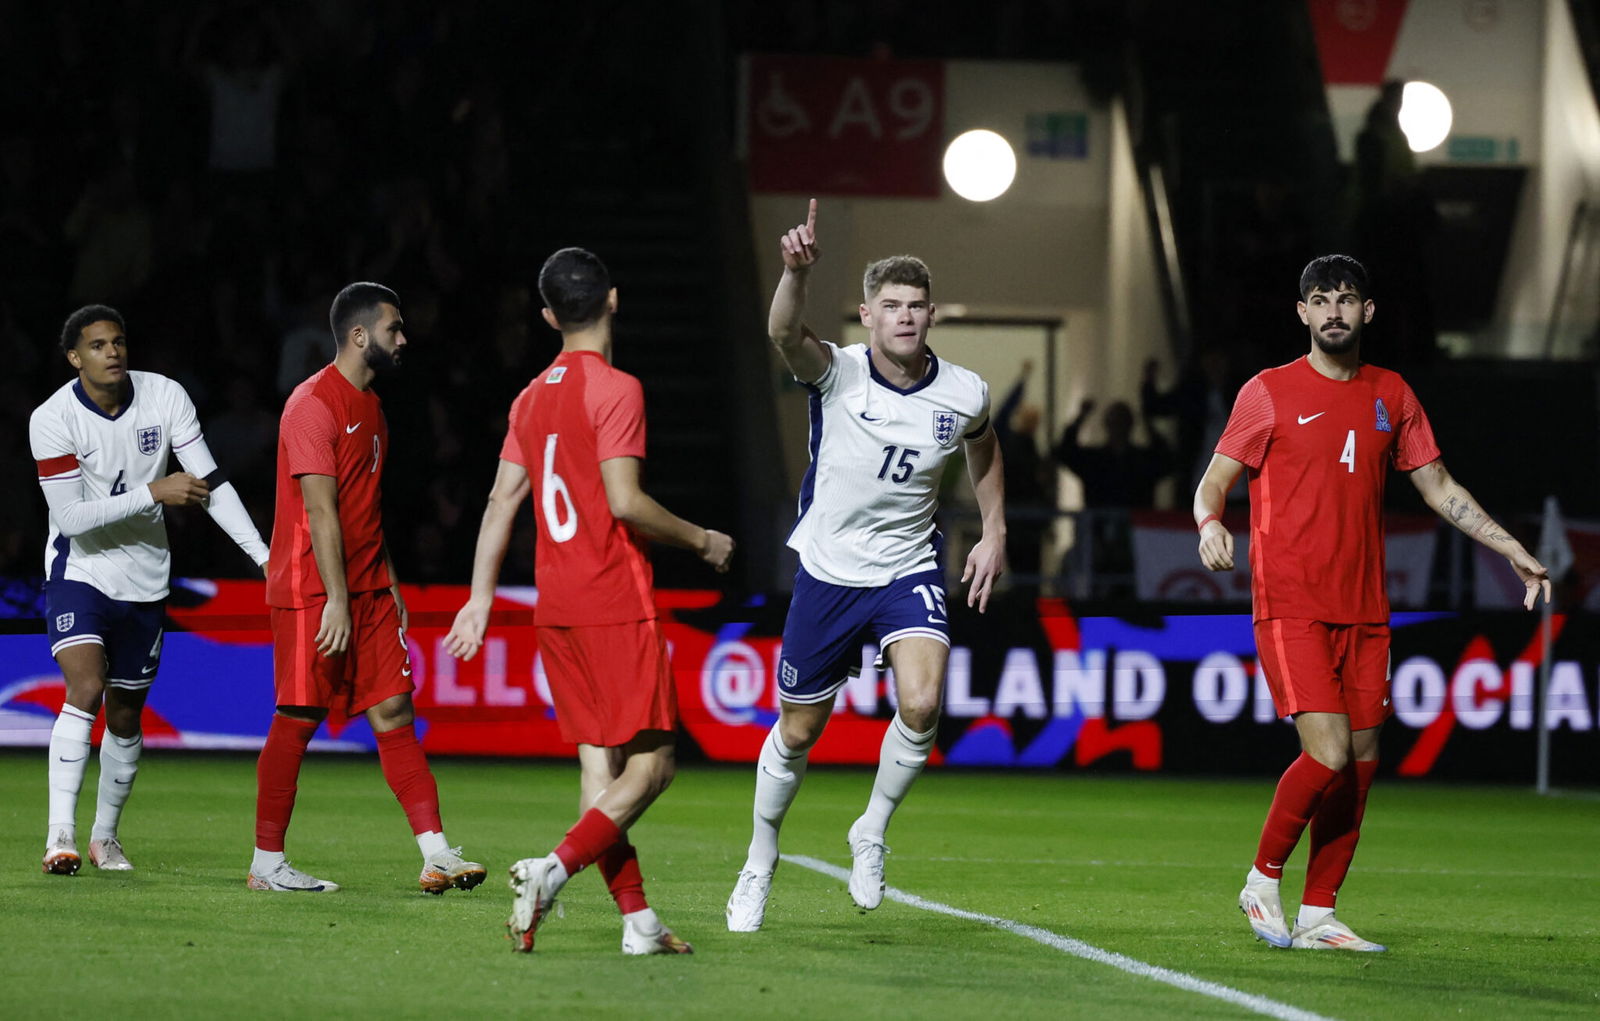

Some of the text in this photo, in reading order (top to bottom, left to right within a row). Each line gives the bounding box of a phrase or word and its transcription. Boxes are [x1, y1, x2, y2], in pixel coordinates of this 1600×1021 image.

[830, 77, 936, 140] A9
[371, 433, 380, 473] 9
[877, 445, 920, 484] 15
[1339, 429, 1356, 473] 4
[110, 469, 128, 497] 4
[541, 433, 578, 543] 6
[912, 584, 947, 618] 15
